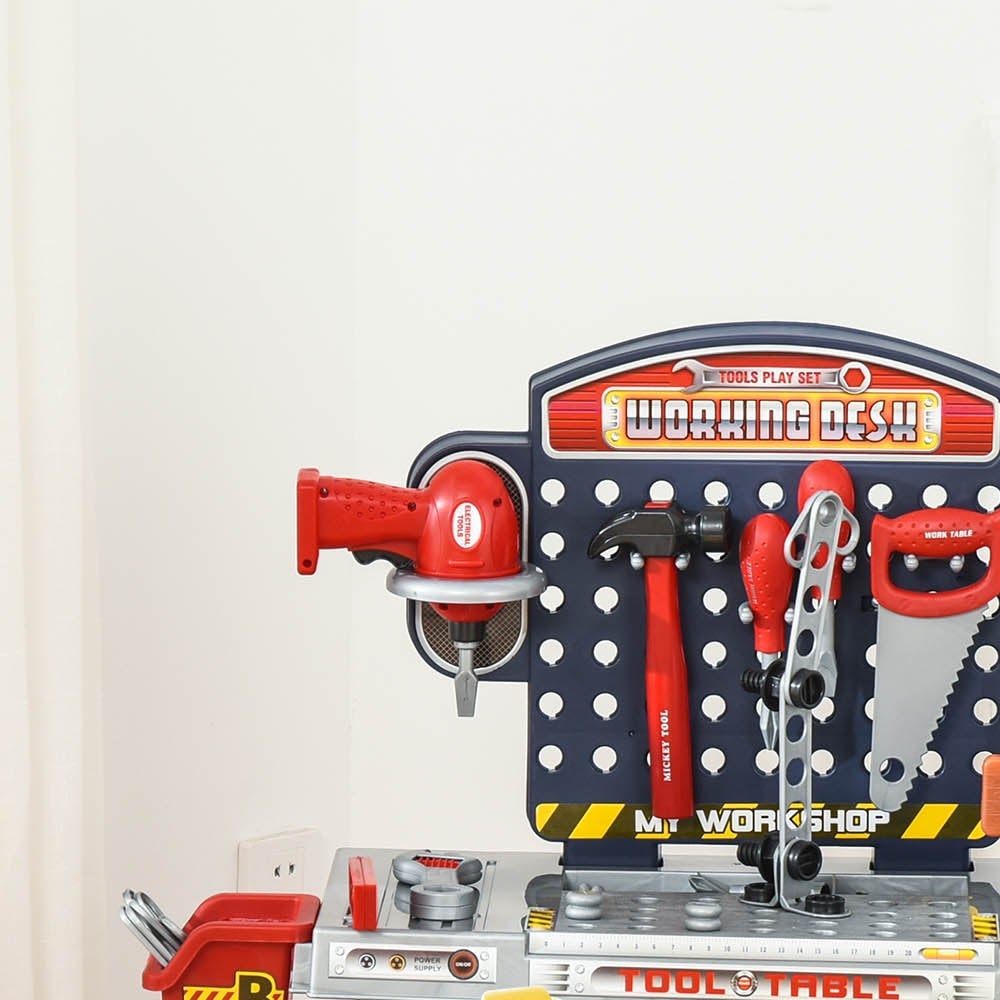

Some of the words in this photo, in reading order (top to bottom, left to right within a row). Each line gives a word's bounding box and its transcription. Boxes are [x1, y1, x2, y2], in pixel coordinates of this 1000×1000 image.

[719, 371, 758, 383] TOOLS
[763, 371, 793, 384] PLAY
[798, 372, 821, 384] SET
[626, 399, 810, 441] WORKING
[820, 400, 917, 442] DESK
[924, 531, 947, 539] WORK
[949, 529, 973, 538] TABLE
[660, 709, 670, 737] TOOL
[661, 740, 672, 782] MICKEY
[618, 969, 725, 995] TOOL
[764, 973, 900, 1000] TABLE
